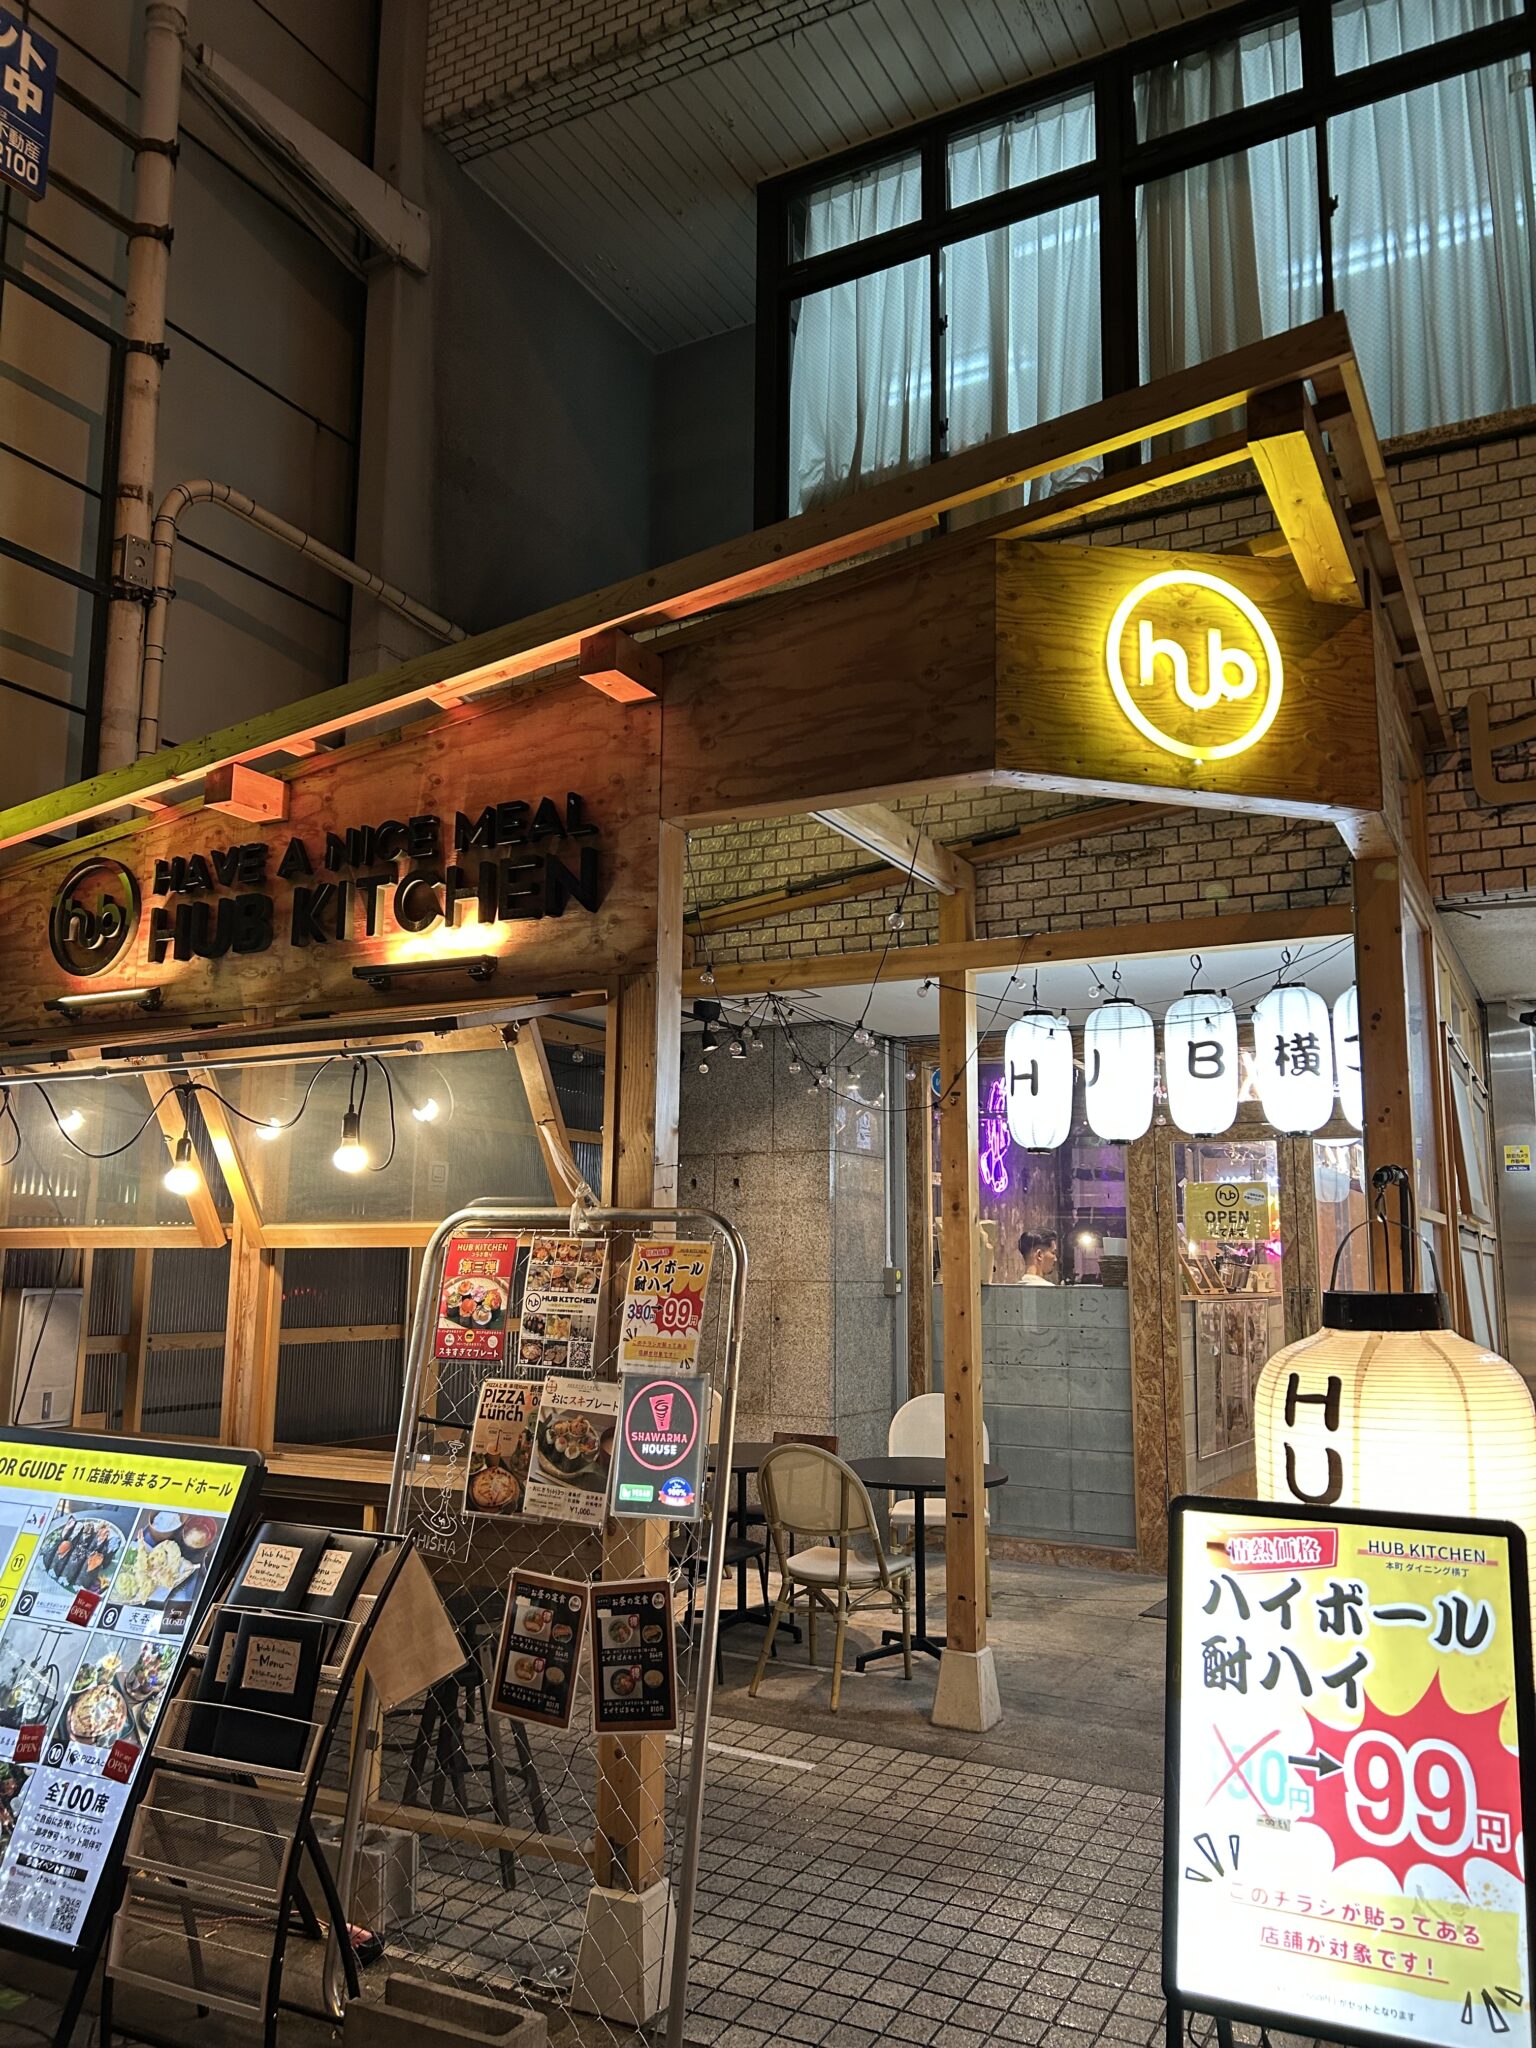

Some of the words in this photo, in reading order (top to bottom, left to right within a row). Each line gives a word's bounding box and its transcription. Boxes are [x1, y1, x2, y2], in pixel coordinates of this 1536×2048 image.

[4, 64, 43, 114] 中
[0, 143, 39, 185] 100
[1138, 619, 1258, 711] hub
[153, 842, 268, 897] HAVE
[277, 836, 315, 880] A
[325, 814, 440, 872] NICE
[455, 791, 599, 853] MEAL
[147, 891, 274, 965] HUB
[290, 846, 602, 948] KITCHEN
[1219, 1190, 1237, 1201] hub
[1204, 1210, 1250, 1224] OPEN
[457, 1243, 475, 1252] HUB
[475, 1243, 508, 1252] KITCHEN
[459, 1258, 499, 1275] 第三弾
[637, 1260, 704, 1276] ハイボール
[634, 1276, 674, 1293] 酎ハイ
[541, 1295, 558, 1303] HUB
[558, 1296, 597, 1305] KITCHEN
[663, 1298, 698, 1327] 99円
[483, 1389, 525, 1405] PIZZA
[552, 1393, 619, 1413] おにスキプレート
[479, 1404, 523, 1422] Lunch
[631, 1431, 688, 1443] SHAWARMA
[642, 1444, 678, 1455] HOUSE
[19, 1458, 68, 1482] GUIDE
[1228, 1537, 1320, 1563] 情熱価格
[1368, 1540, 1404, 1556] HUB
[1409, 1544, 1486, 1563] KITCHEN
[1385, 1561, 1403, 1572] 本町
[1405, 1562, 1469, 1578] ダイニング横丁
[531, 1589, 567, 1604] お昼の定食
[612, 1594, 649, 1607] お昼の定食
[70, 1605, 90, 1620] OPEN
[1202, 1574, 1489, 1648] ハイボール
[260, 1654, 284, 1669] Menu
[1201, 1635, 1368, 1709] 酎ハイ
[16, 1743, 38, 1753] OPEN
[107, 1757, 131, 1774] OPEN
[45, 1782, 110, 1813] 全100席
[1350, 1736, 1512, 1854] 99円
[1230, 1881, 1481, 1946] このチラシが貼ってある
